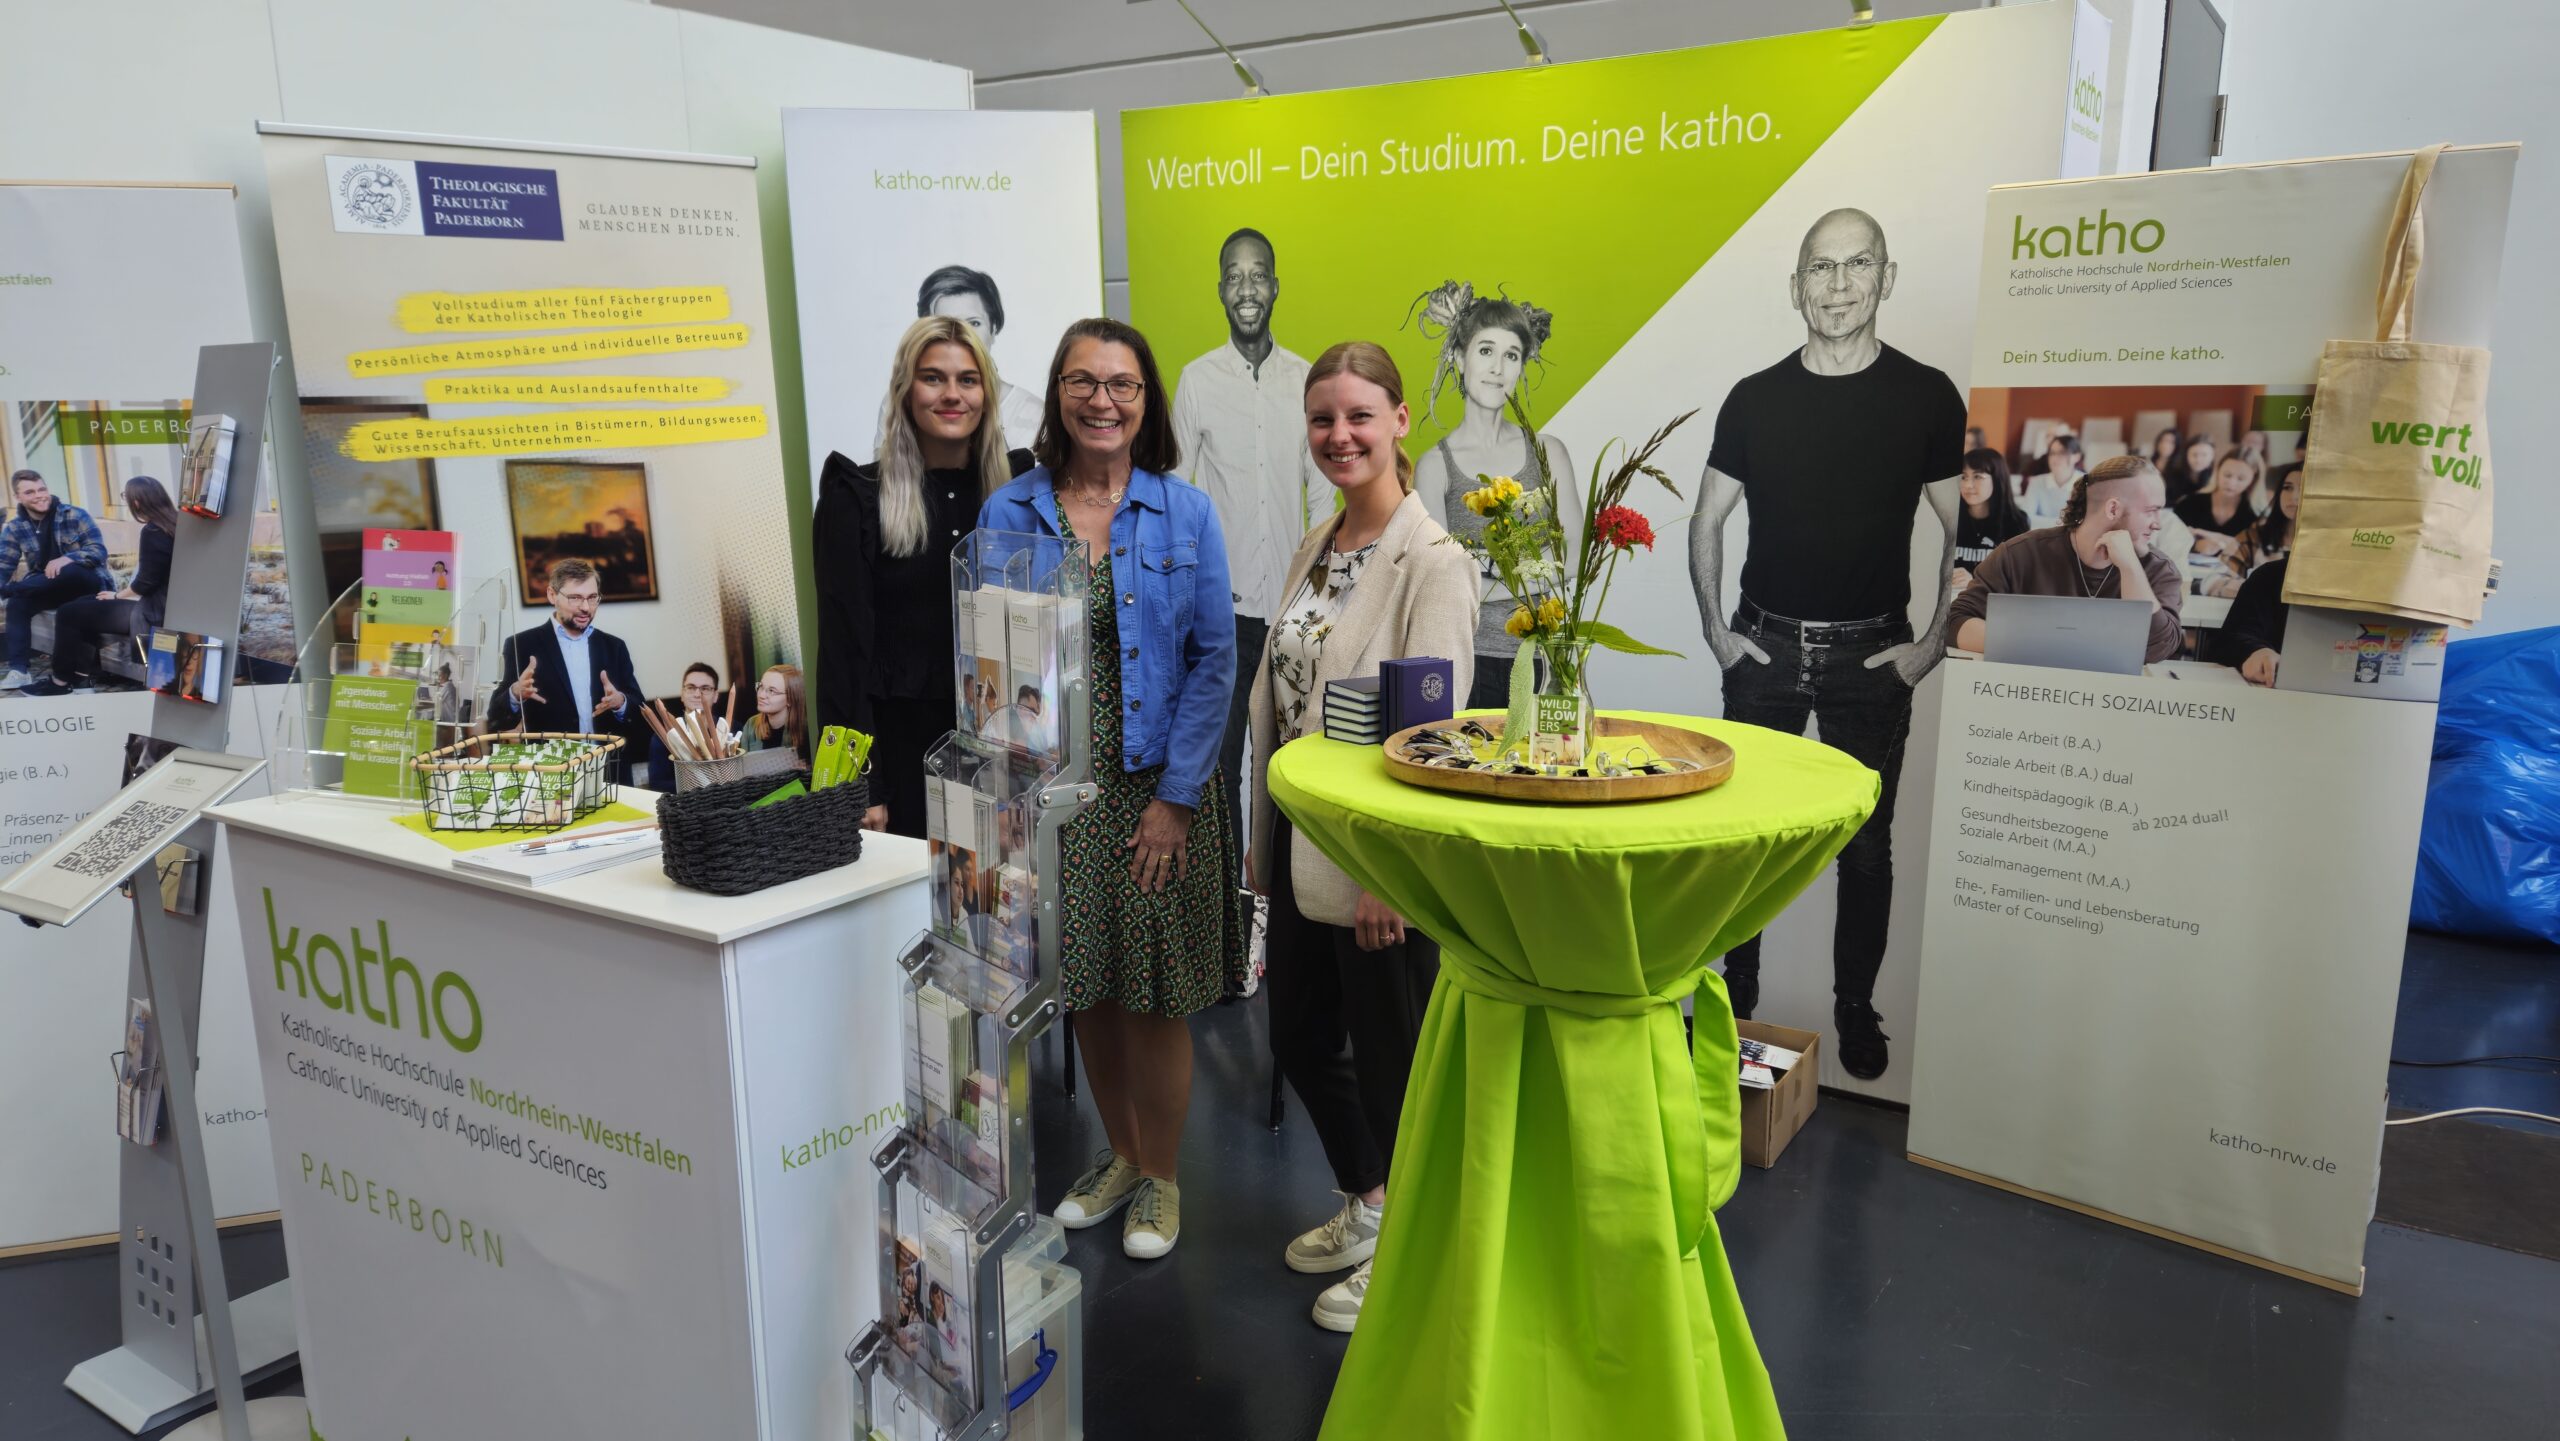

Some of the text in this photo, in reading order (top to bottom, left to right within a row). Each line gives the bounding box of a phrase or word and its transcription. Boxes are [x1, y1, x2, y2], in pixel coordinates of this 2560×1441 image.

[1147, 147, 1262, 191] Wertvoll
[1301, 143, 1368, 181] Dein
[1379, 131, 1527, 177] Studium.
[1542, 121, 1645, 163] Deine
[1659, 104, 1784, 151] katho.
[874, 169, 1012, 191] katho-nrw.de
[586, 203, 739, 222] GLAUBEN DENKEN.
[578, 219, 741, 238] MENSCHEN BILDEN.
[2012, 208, 2166, 260] katho
[2010, 255, 2290, 280] Katholische Hochschule Nordrhein-Westfalen
[2008, 276, 2233, 297] Catholic University of Applied Sciences
[432, 292, 713, 312] Vollstudium aller fünf Fächergruppen
[435, 308, 643, 325] der Katholischen Theologie
[354, 329, 744, 369] Persönliche Atmosphäre und individuelle Betreuung
[2003, 346, 2225, 364] Dein Studium. Deine katho.
[444, 382, 699, 395] Praktika und Auslandsaufenthalte
[89, 419, 193, 434] PADERB
[371, 413, 762, 441] Gute Berufsaussichten in Bistümern, Bildungswesen,
[2371, 420, 2473, 453] wert
[2431, 454, 2482, 490] voll.
[2352, 529, 2395, 544] katho
[1540, 699, 1571, 710] WILD
[1973, 681, 2236, 722] FACHBEREICH SOZIALWESEN
[1540, 710, 1576, 721] FLOW
[1540, 721, 1560, 731] ERS
[350, 725, 382, 736] Soziale
[350, 739, 360, 747] ist
[1968, 724, 2102, 752] Soziale Arbeit (B.A.)
[349, 752, 365, 761] Nur
[1966, 752, 2134, 786] Soziale Arbeit (B.A.) dual
[1964, 779, 2140, 816] Kindheitspädagogik (B.A.)
[4, 814, 70, 827] Präsenz-
[1961, 806, 2109, 841] Gesundheitsbezogene
[2132, 809, 2230, 832] ab 2024 dual!
[1959, 823, 2097, 857] Soziale Arbeit (M.A.)
[0, 851, 32, 864] eich
[1957, 850, 2131, 892] Sozialmanagement (M.A.)
[1953, 894, 2104, 935] (Master of Counseling)
[1955, 877, 2200, 936] Ehe-, Familien- und Lebensberatung
[262, 887, 483, 1054] katho
[281, 1012, 693, 1176] Katholische Hochschule Nordrhein-Westfalen
[205, 1108, 267, 1125] katho-
[287, 1051, 608, 1190] Catholic University of Applied Sciences
[2209, 1127, 2337, 1174] katho-nrw.de
[300, 1152, 505, 1268] PADERBORN
